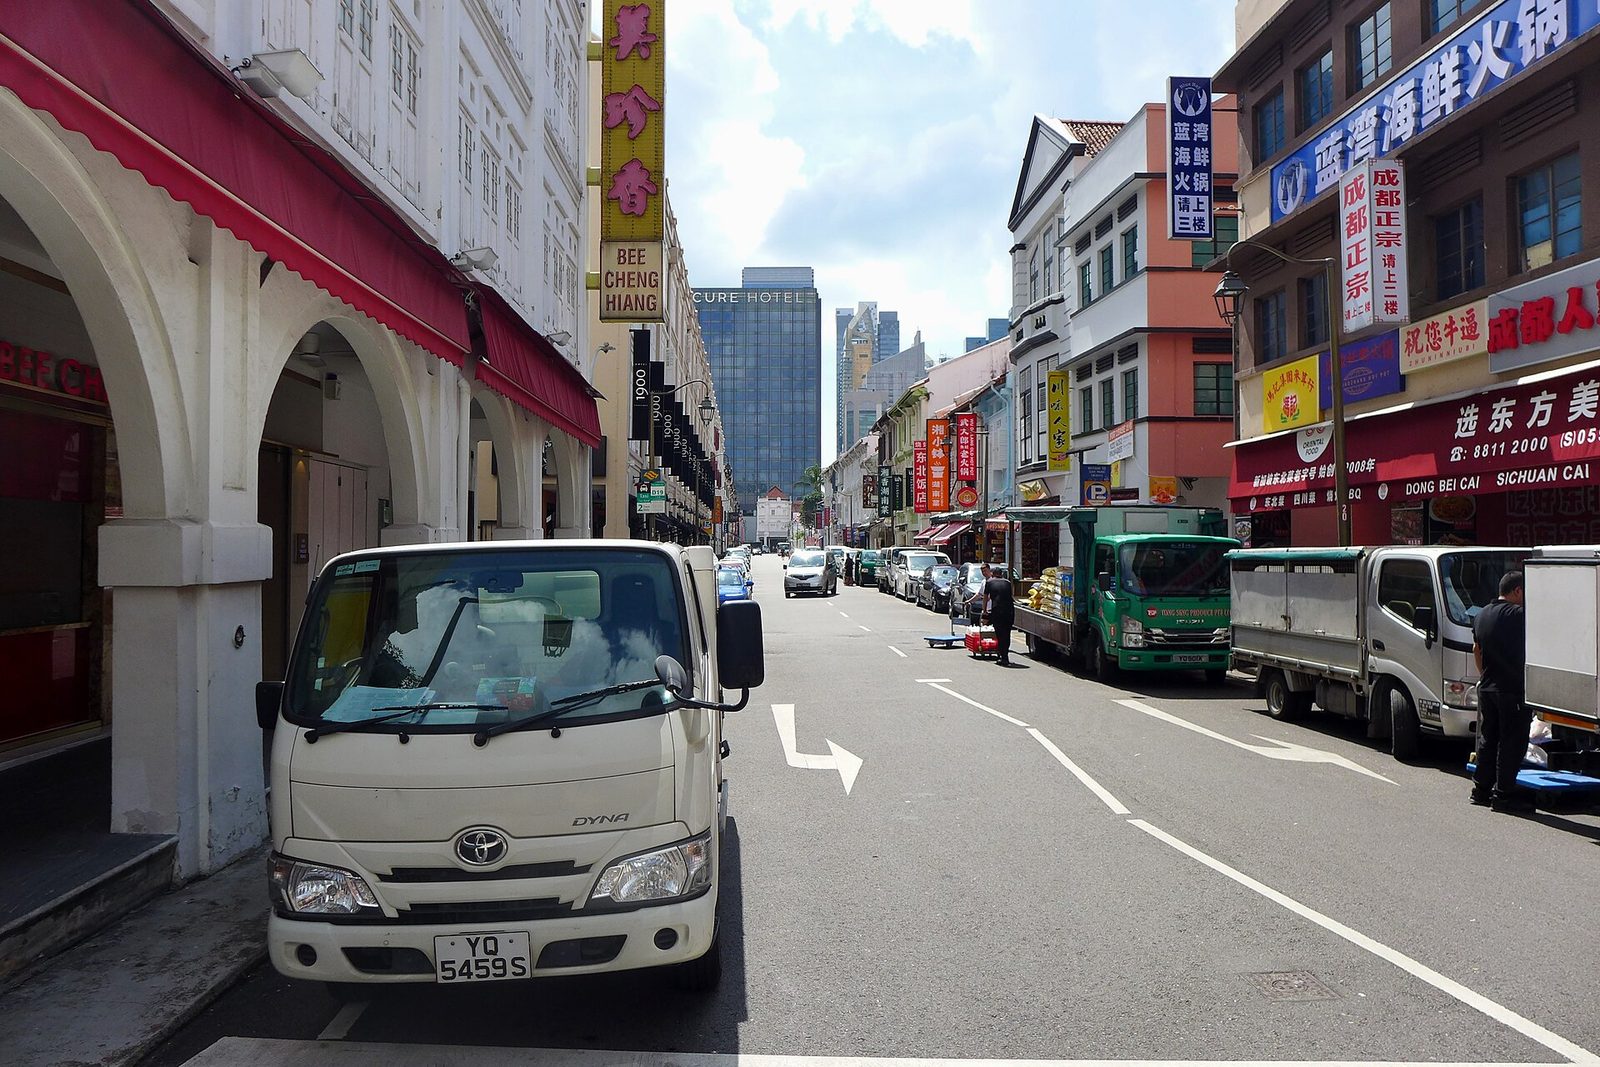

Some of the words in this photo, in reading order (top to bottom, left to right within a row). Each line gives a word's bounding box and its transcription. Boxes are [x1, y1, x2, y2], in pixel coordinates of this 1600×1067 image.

[1315, 0, 1567, 195] 蓝湾海鲜火锅
[1174, 122, 1209, 142] 蓝湾
[1174, 147, 1210, 167] 海鲜
[1174, 172, 1209, 192] 火锅
[1178, 197, 1205, 213] 请上
[1373, 169, 1403, 248] 成都正宗
[1178, 216, 1206, 232] 三楼
[1343, 173, 1369, 301] 成都正宗
[617, 248, 646, 264] BEE
[605, 271, 658, 288] CHENG
[1382, 254, 1399, 315] 请上二楼
[606, 294, 657, 311] HIANG
[747, 292, 805, 304] HOTEL
[1487, 280, 1600, 353] 成都人
[1405, 307, 1481, 357] 祝您牛逼
[0, 341, 53, 388] BEE
[61, 358, 109, 404] CH
[635, 369, 649, 401] 1900
[652, 395, 663, 421] 1900
[1050, 378, 1067, 450] 川味人家
[1454, 379, 1600, 439] 选东方美
[663, 414, 674, 438] 1900
[673, 427, 682, 450] 1900
[1302, 437, 1325, 450] ORIENTAL
[1473, 441, 1505, 459] 8811
[1510, 436, 1548, 454] 2000
[1560, 427, 1600, 450] (S)05
[1305, 446, 1319, 456] FOOD
[1346, 457, 1375, 474] 008年
[1406, 480, 1435, 495] DONG
[1439, 478, 1457, 492] BEI
[1459, 476, 1480, 490] CAI
[1496, 467, 1557, 486] SICHUAN
[1562, 464, 1590, 481] CAI
[1341, 505, 1348, 521] 20
[572, 813, 630, 827] DYNA
[465, 936, 499, 957] YQ
[440, 956, 527, 981] 5459S
